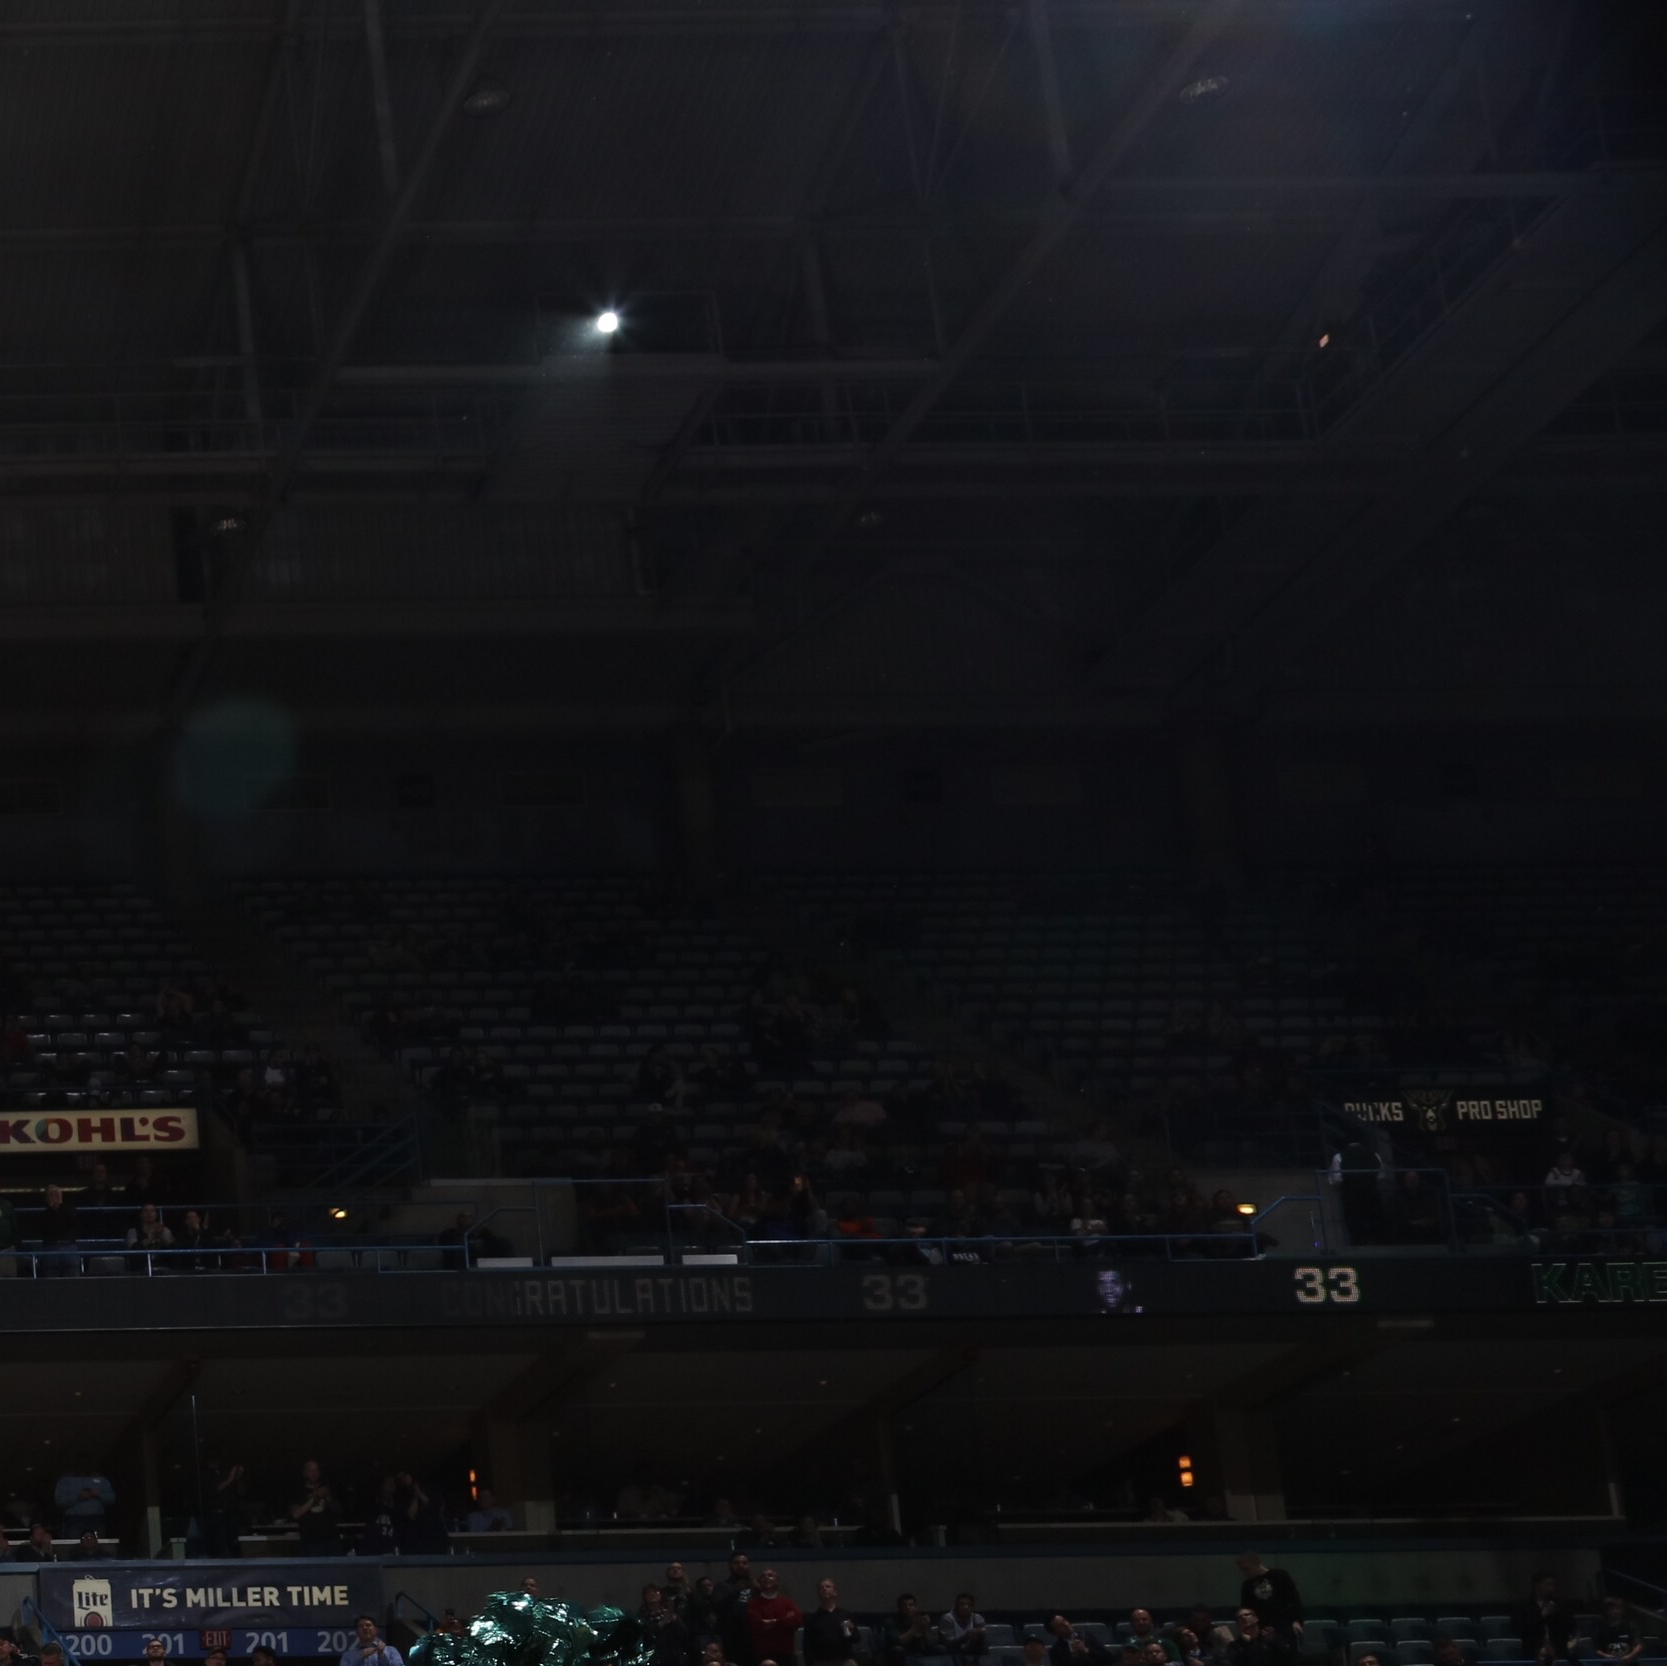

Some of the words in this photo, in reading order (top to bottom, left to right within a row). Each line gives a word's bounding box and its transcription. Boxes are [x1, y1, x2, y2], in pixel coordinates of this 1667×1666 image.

[1455, 1100, 1492, 1121] PRO
[1494, 1099, 1544, 1120] SHOP
[861, 1274, 929, 1311] 33
[1293, 1266, 1362, 1304] 33
[77, 1591, 109, 1611] Lite
[130, 1588, 178, 1609] IT'S
[186, 1586, 280, 1608] MILLER
[286, 1585, 350, 1607] TIME
[66, 1633, 113, 1656] 200
[205, 1632, 228, 1648] EXIT
